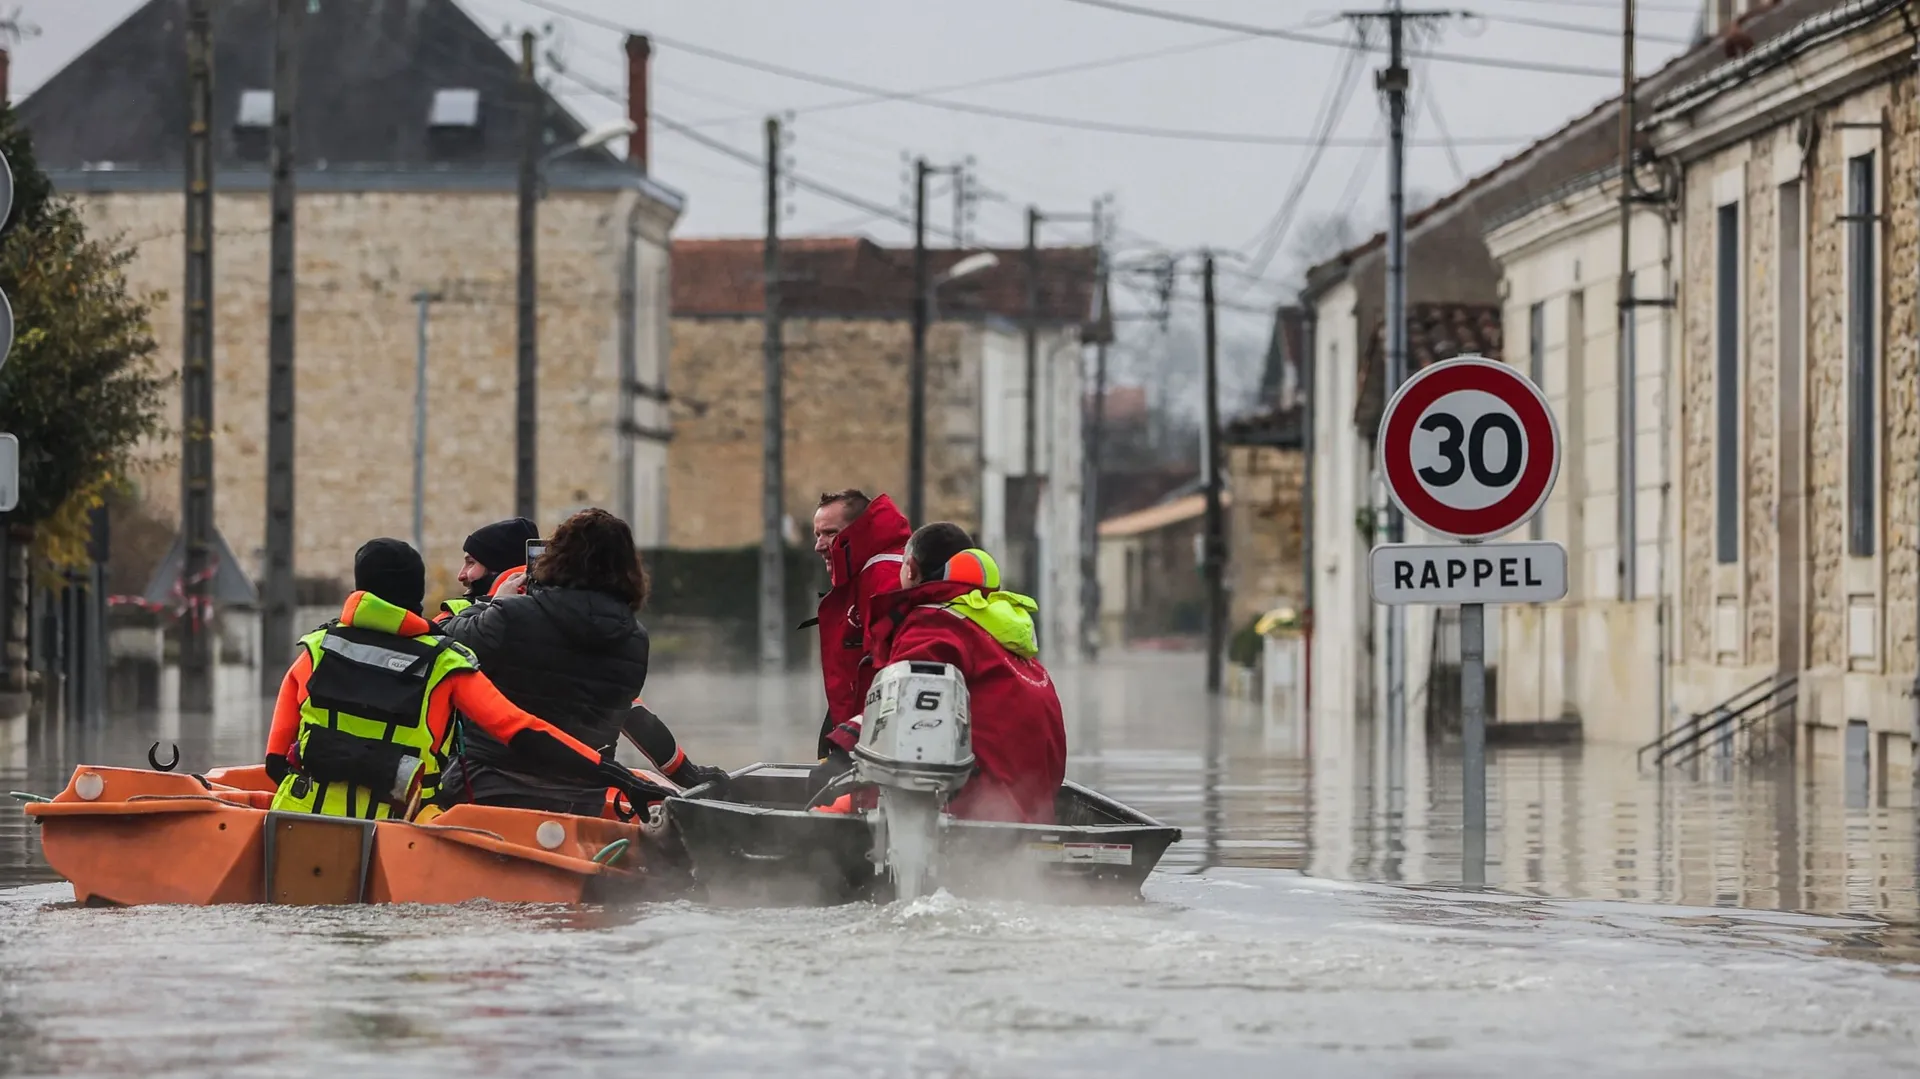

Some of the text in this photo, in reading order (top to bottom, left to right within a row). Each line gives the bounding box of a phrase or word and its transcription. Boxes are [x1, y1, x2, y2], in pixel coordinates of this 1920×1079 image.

[1418, 412, 1523, 488] 30
[1394, 557, 1542, 590] RAPPEL
[915, 691, 941, 711] 6
